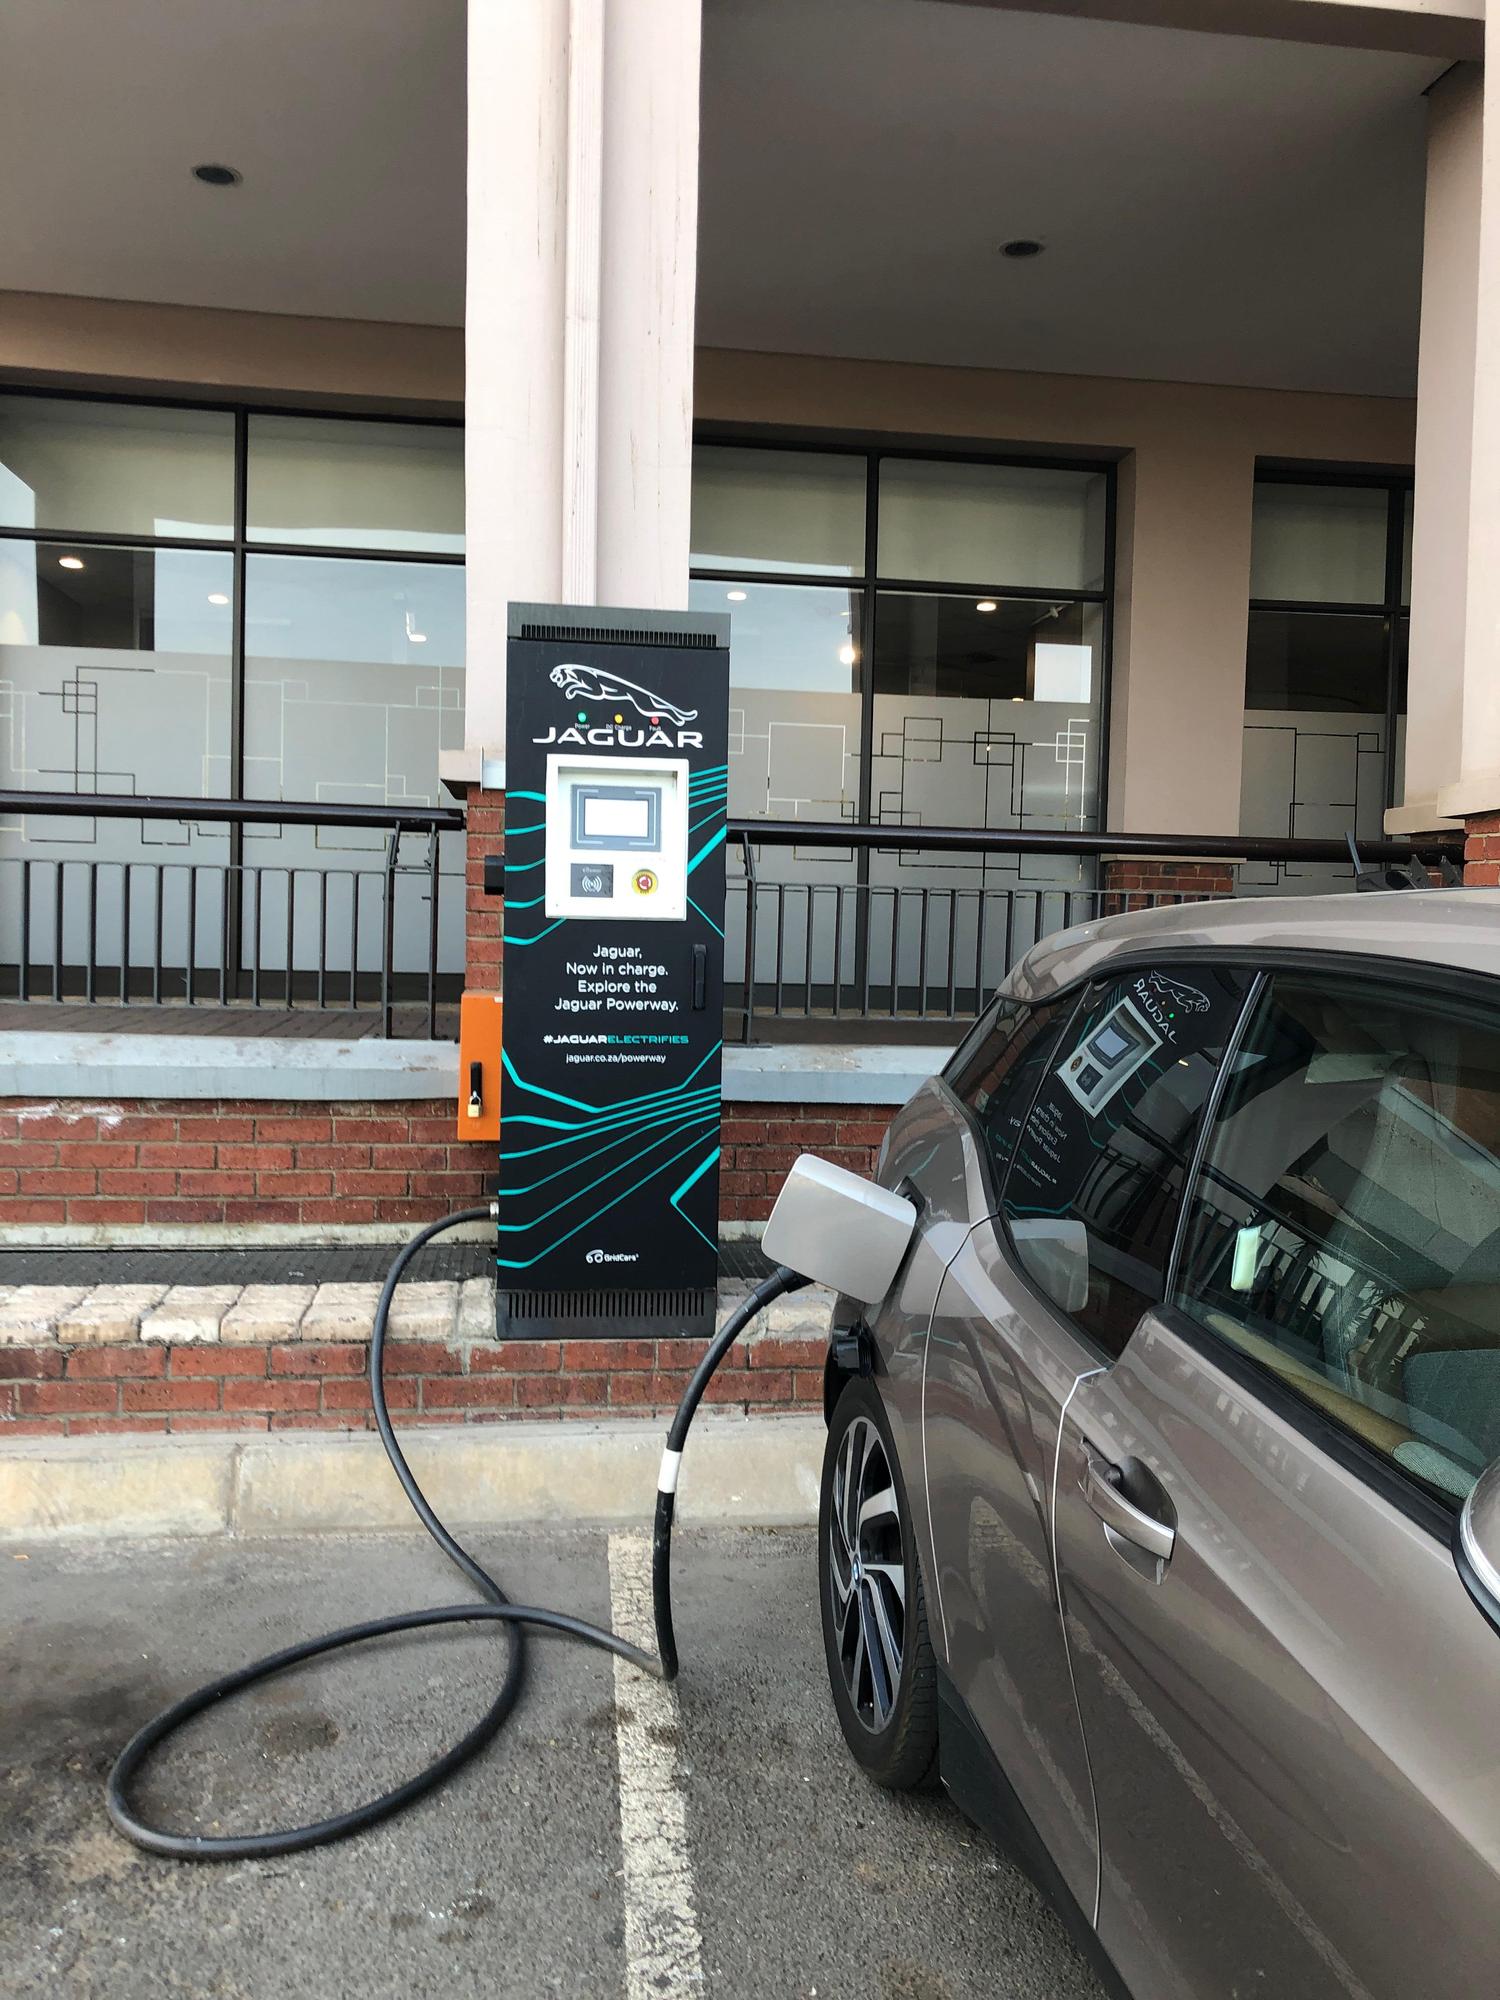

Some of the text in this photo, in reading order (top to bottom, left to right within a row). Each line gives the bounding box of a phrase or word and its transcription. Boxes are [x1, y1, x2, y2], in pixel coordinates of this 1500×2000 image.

[532, 726, 704, 749] JAGUAR
[593, 944, 642, 959] Jaguar,
[566, 962, 668, 977] Now in charge.
[578, 980, 657, 995] Explore the
[554, 998, 679, 1013] Jaguar Powerway.
[566, 1053, 667, 1064] jaguar.co.za/powerway
